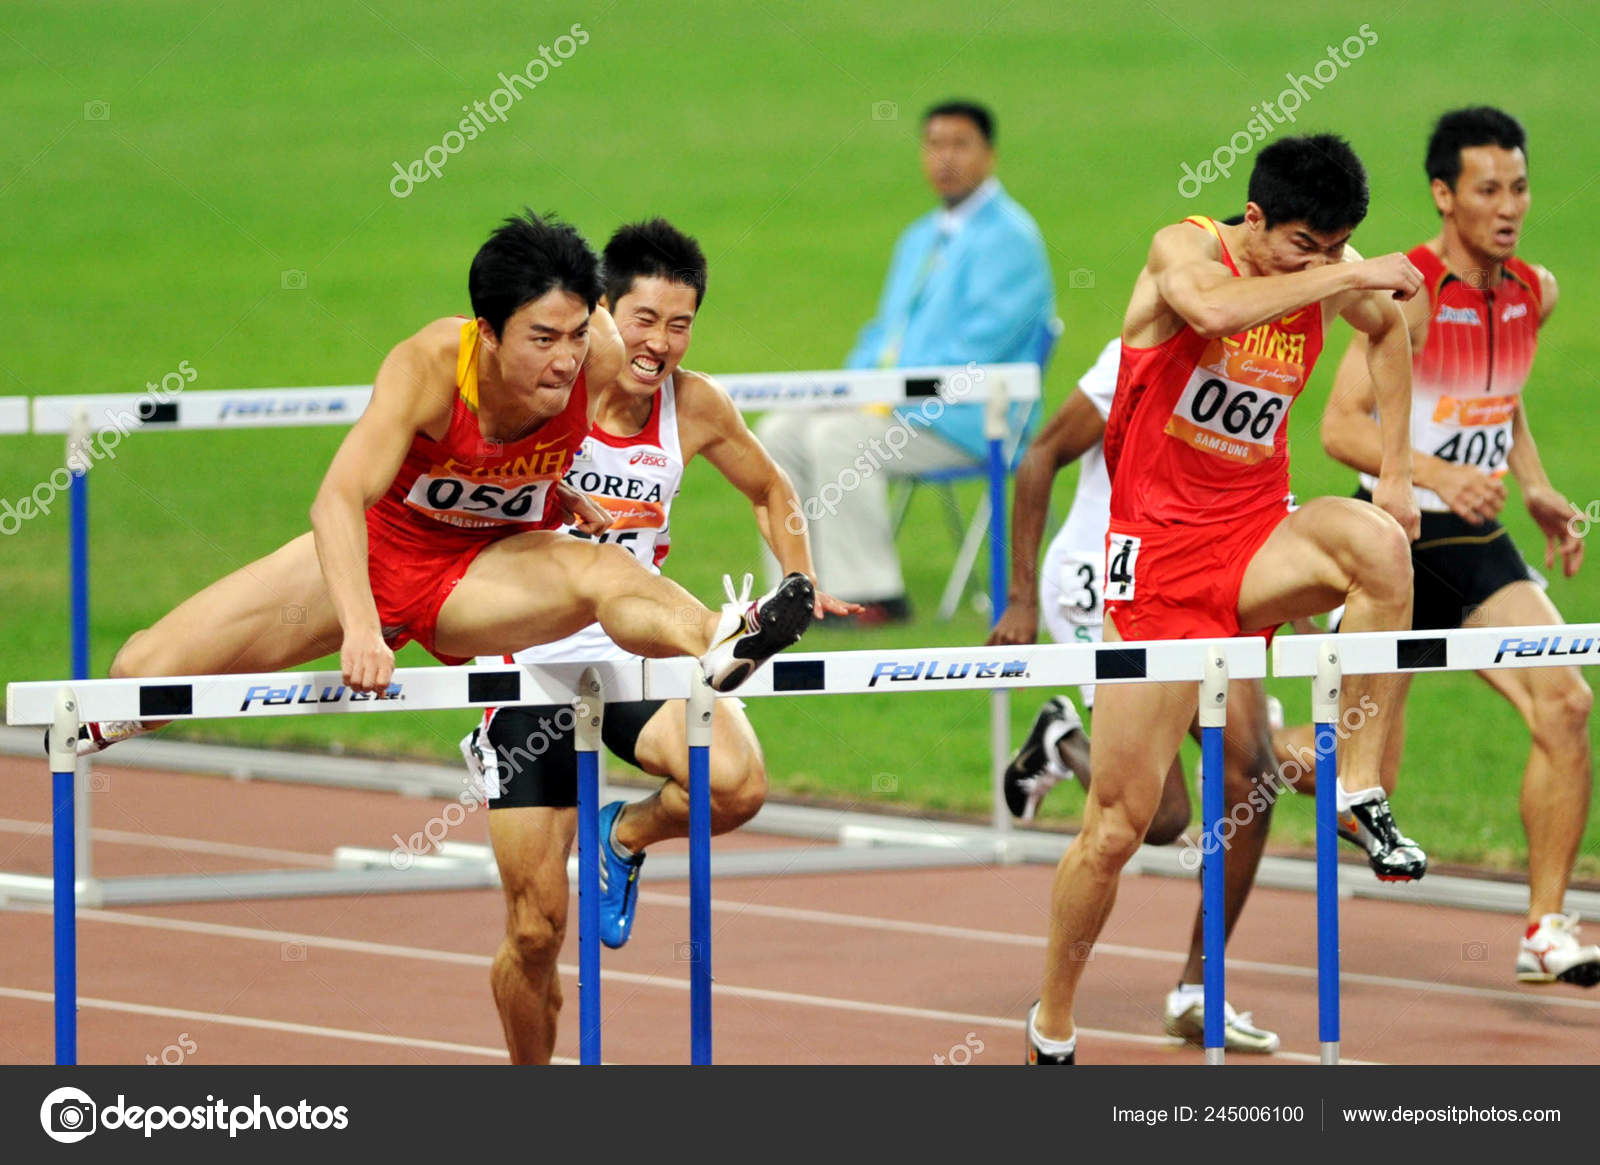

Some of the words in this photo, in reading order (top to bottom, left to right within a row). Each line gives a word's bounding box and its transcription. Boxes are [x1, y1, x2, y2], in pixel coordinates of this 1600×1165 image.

[1191, 378, 1283, 439] 066
[642, 455, 669, 468] asics
[1194, 432, 1249, 458] SAMSUNG
[1434, 428, 1507, 468] 408
[426, 478, 537, 517] 056
[562, 470, 662, 503] KOREA
[434, 512, 504, 529] SAMSUN
[1110, 539, 1134, 594] 4
[1076, 564, 1096, 612] 3
